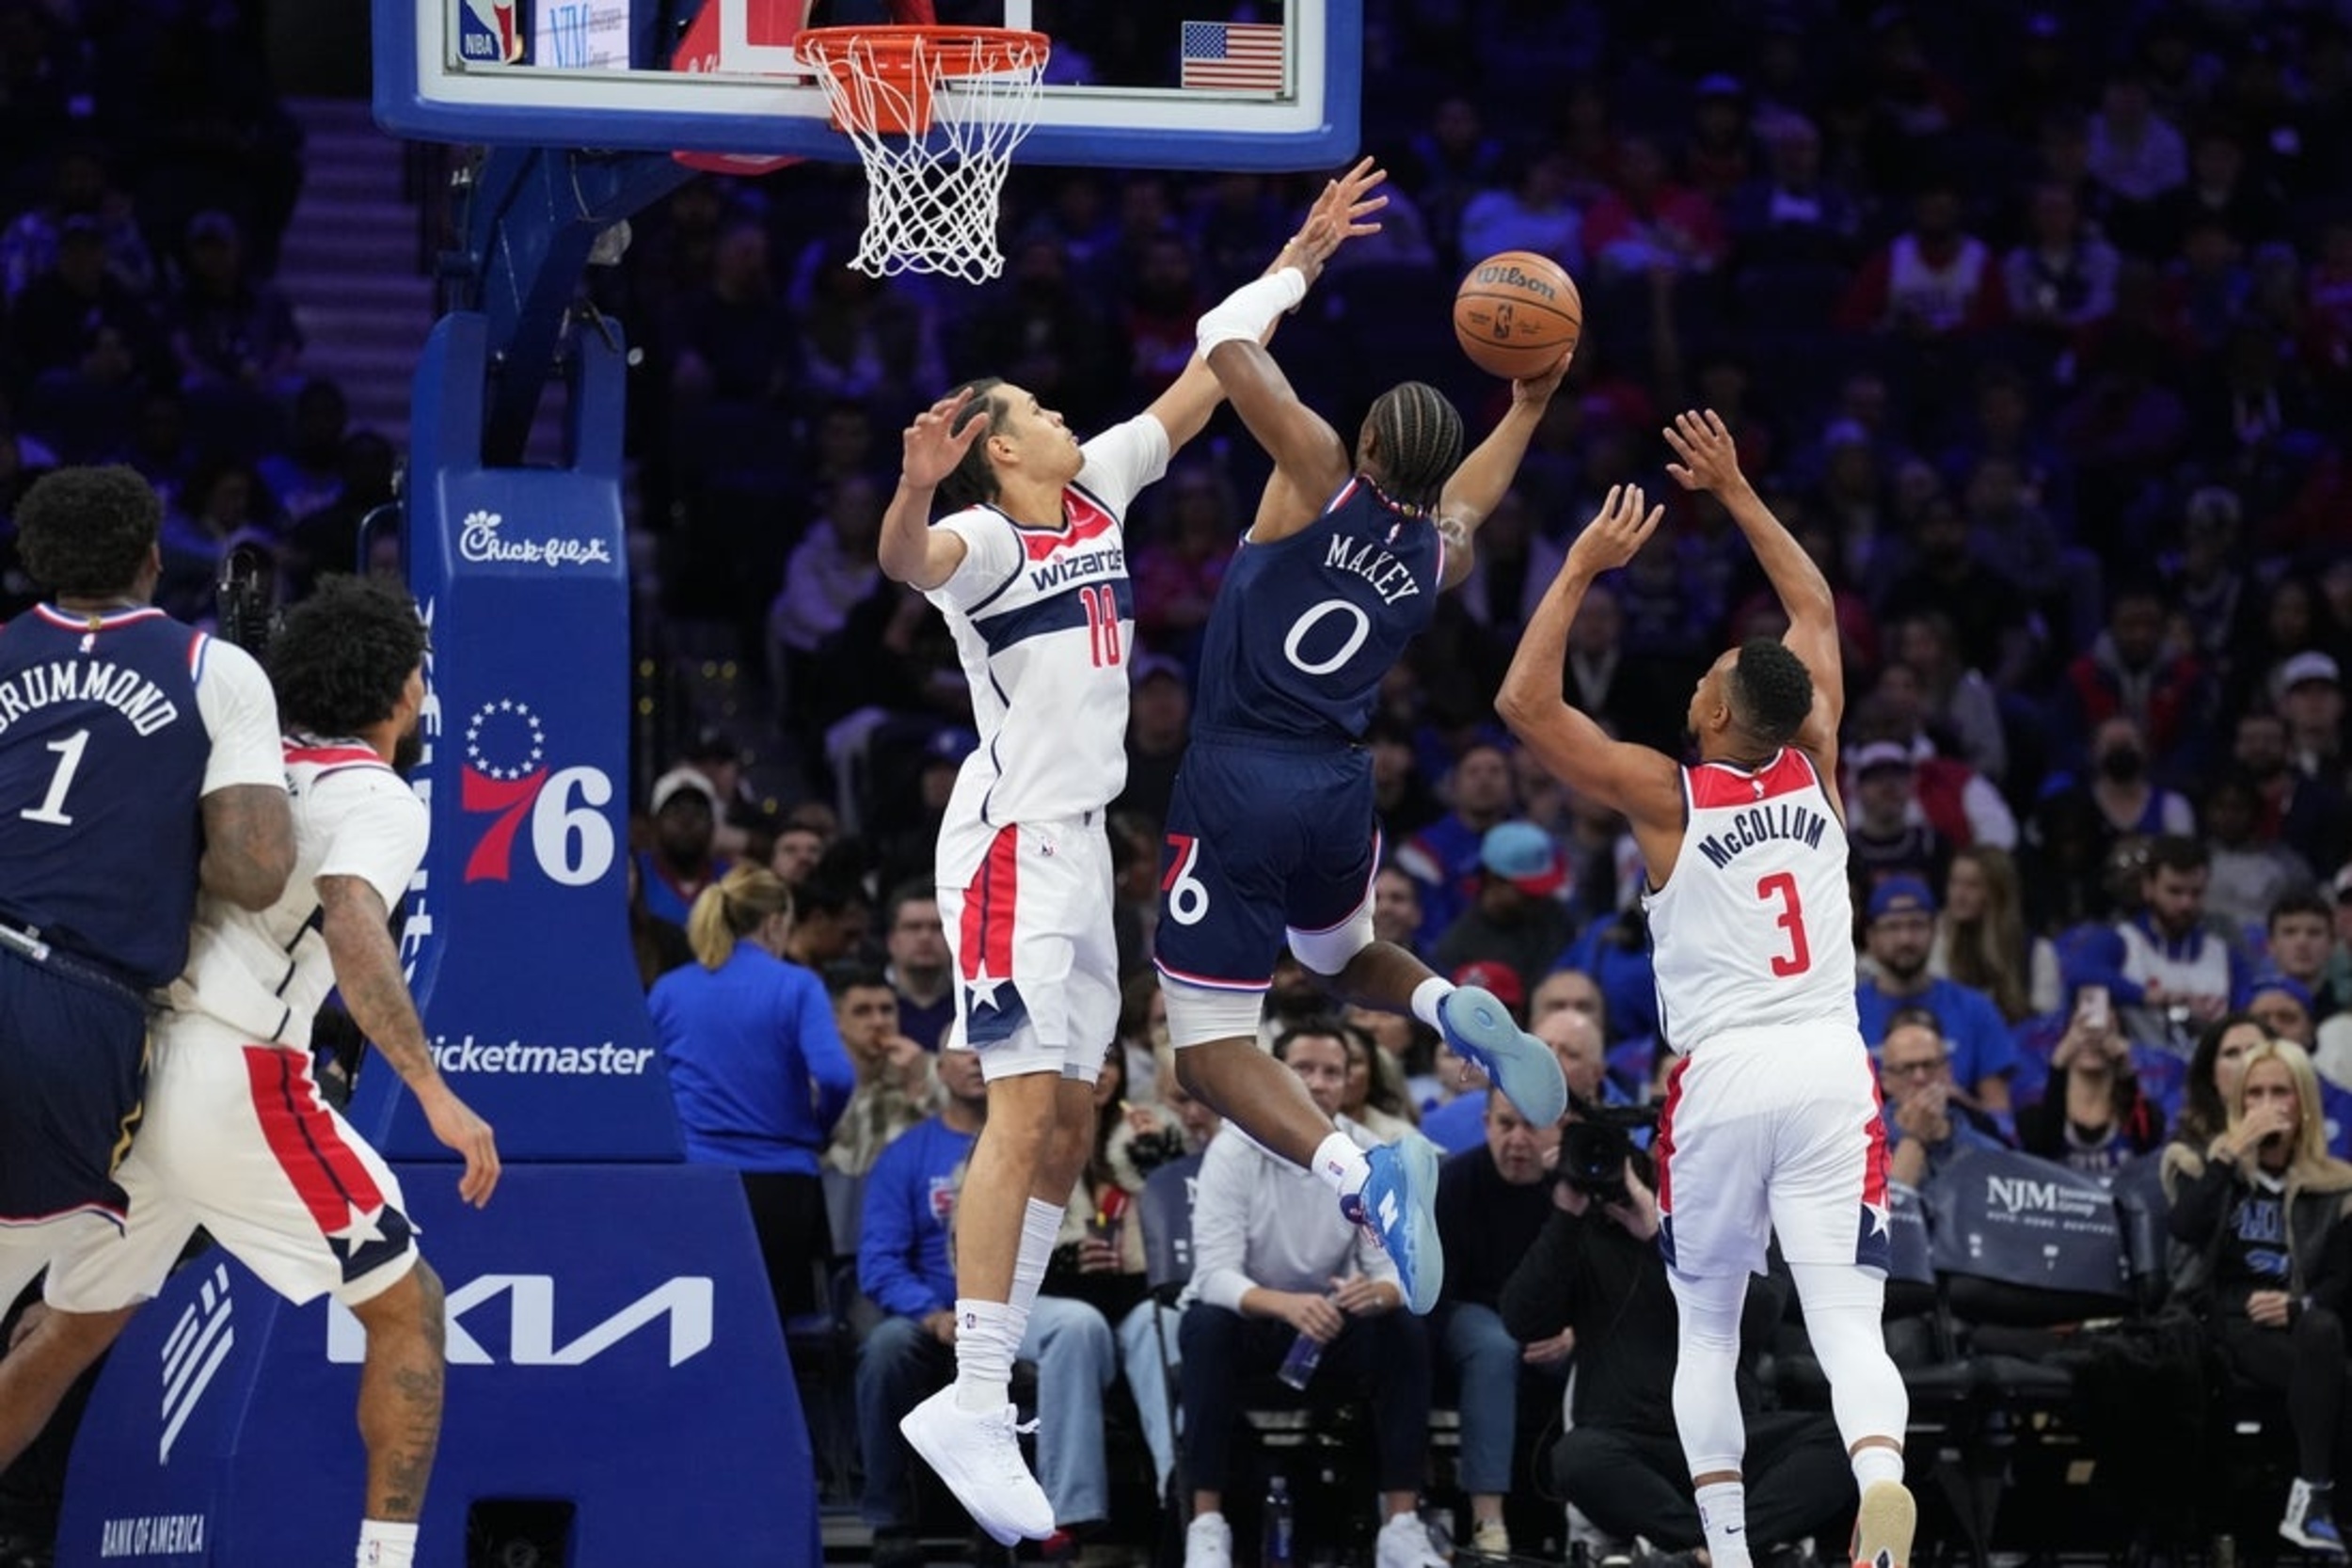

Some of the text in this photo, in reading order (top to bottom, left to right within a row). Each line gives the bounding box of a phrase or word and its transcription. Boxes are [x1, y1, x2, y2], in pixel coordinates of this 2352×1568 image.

[466, 34, 493, 55] NBA
[1477, 267, 1556, 301] Wilson
[460, 511, 612, 566] Chick-fil-A
[1324, 532, 1421, 607] MAXEY
[1079, 584, 1120, 669] 18
[1283, 598, 1371, 675] 0
[0, 660, 179, 737] RUMMOND
[20, 729, 90, 826] 1
[461, 765, 615, 887] 76
[1697, 804, 1827, 870] McCOLLUM
[1161, 833, 1209, 926] 76
[1756, 871, 1811, 978] 3
[1987, 1176, 2056, 1213] NJM
[101, 1513, 204, 1557] BANK OF AMERICA
